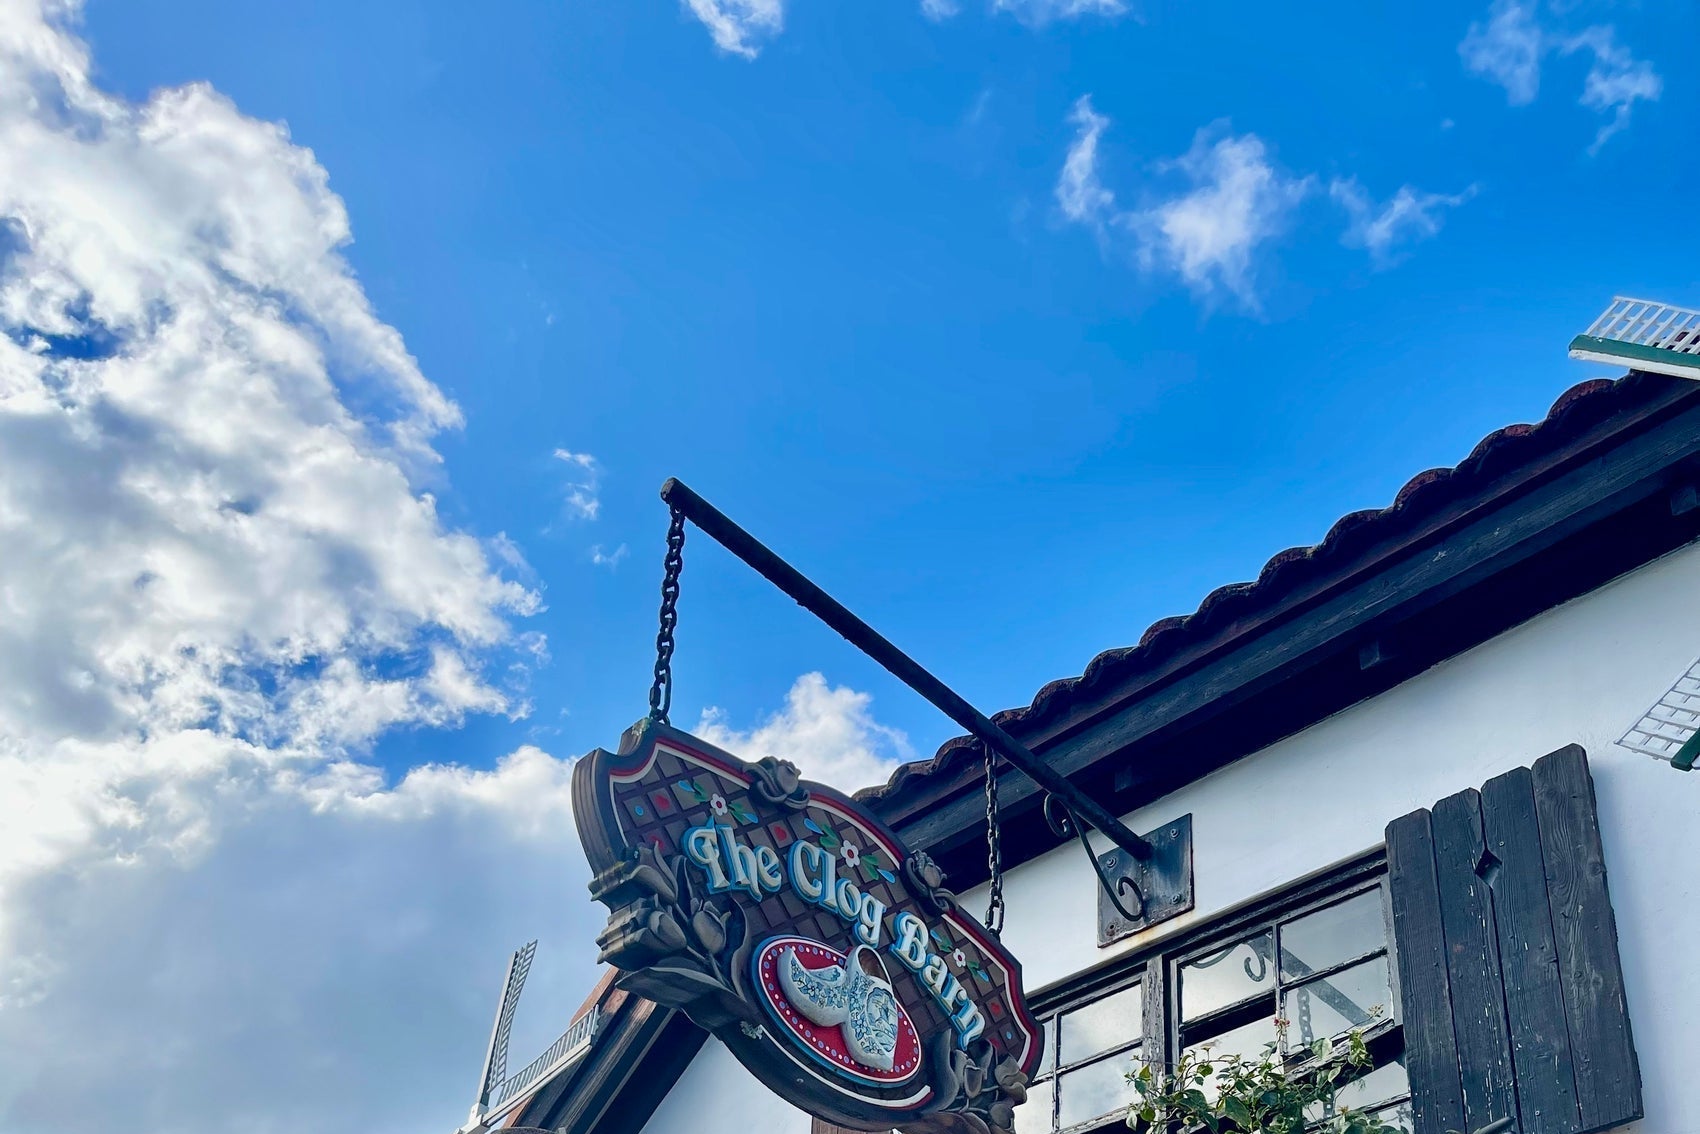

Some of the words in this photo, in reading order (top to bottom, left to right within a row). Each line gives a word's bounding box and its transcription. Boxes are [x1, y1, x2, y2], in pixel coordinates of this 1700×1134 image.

[680, 815, 783, 902] The
[789, 840, 886, 948] Clog
[890, 911, 986, 1051] Barn
